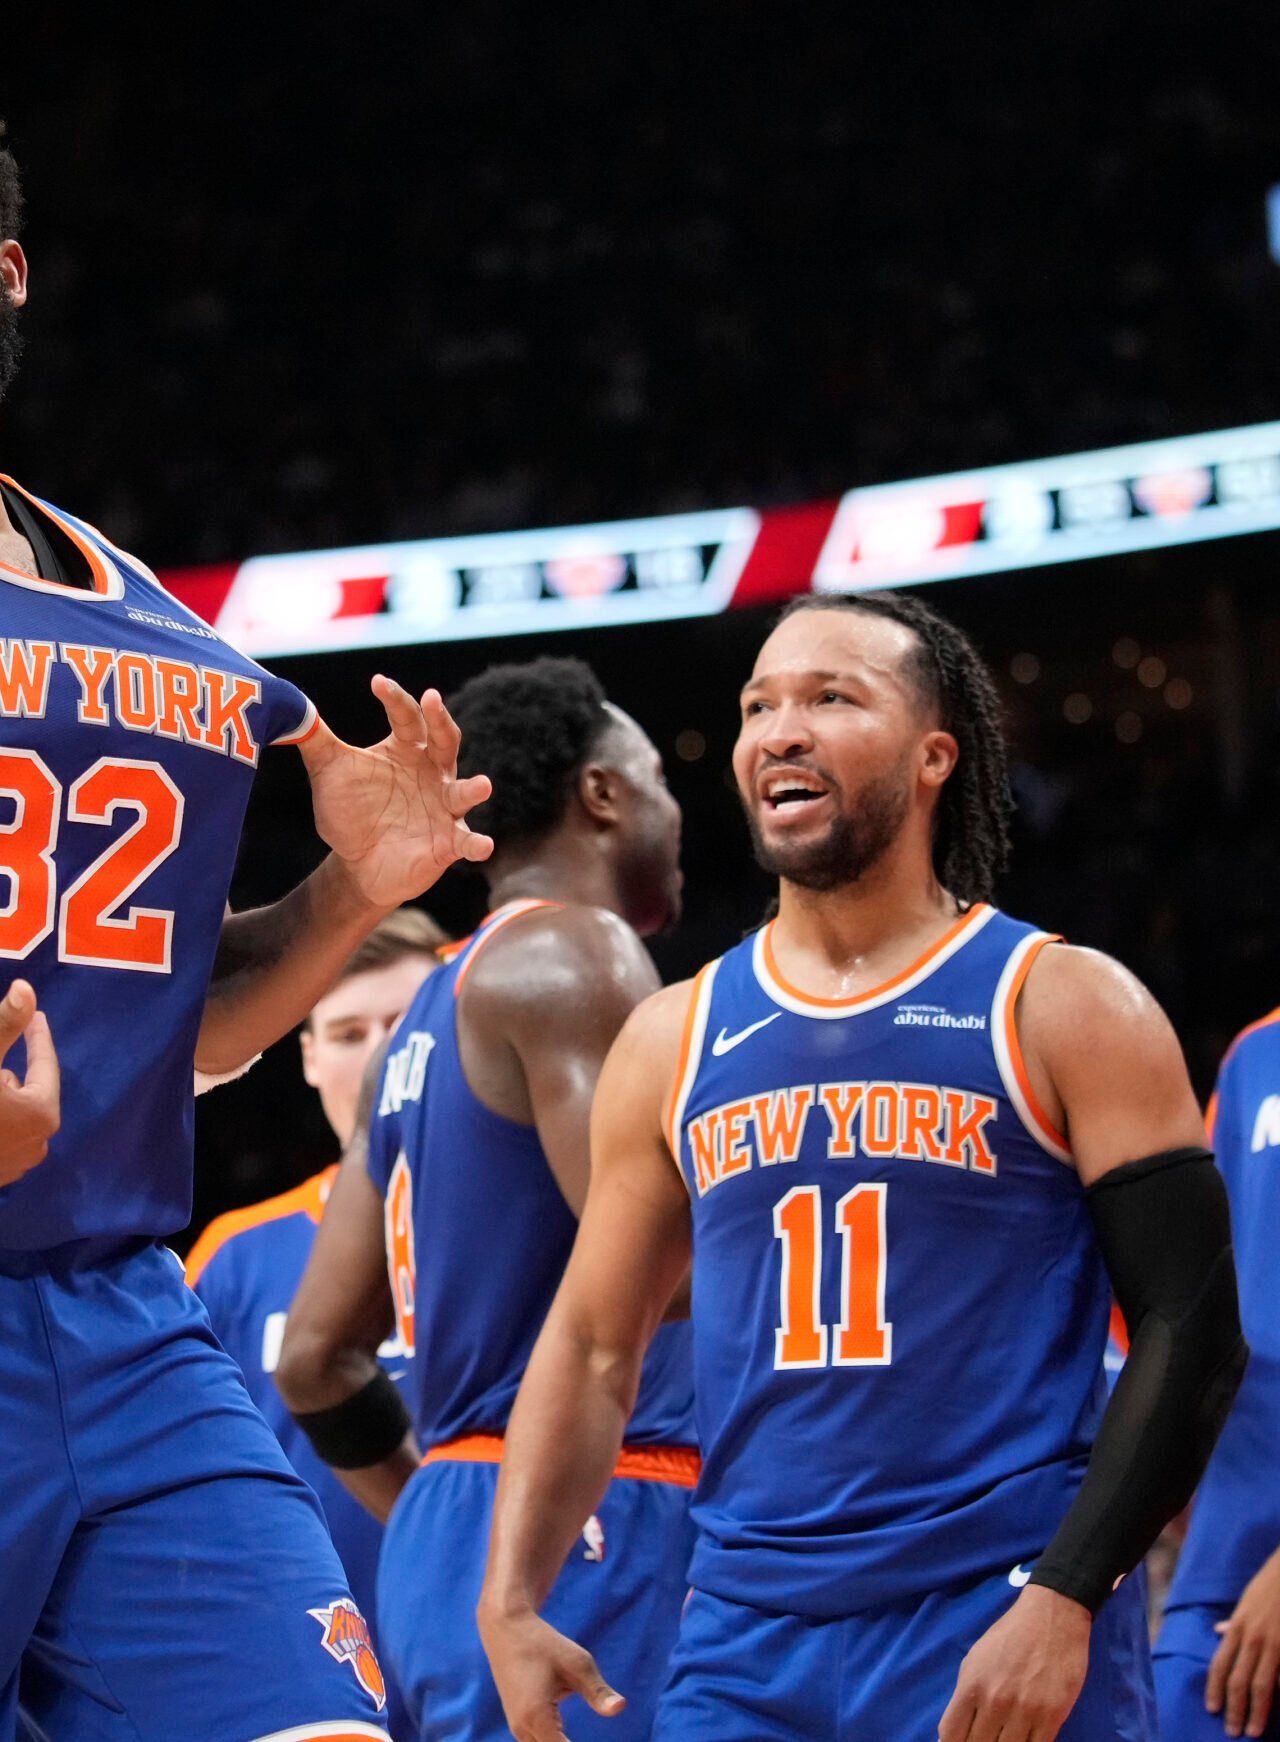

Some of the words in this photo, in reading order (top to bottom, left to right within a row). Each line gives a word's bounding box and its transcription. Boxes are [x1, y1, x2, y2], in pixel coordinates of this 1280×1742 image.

[128, 611, 163, 627] abu
[59, 642, 262, 770] YORK
[893, 1011, 931, 1026] abu
[932, 1014, 986, 1030] dhabi
[688, 1084, 816, 1199] NEW
[818, 1080, 998, 1178] YORK
[773, 1183, 893, 1371] 11
